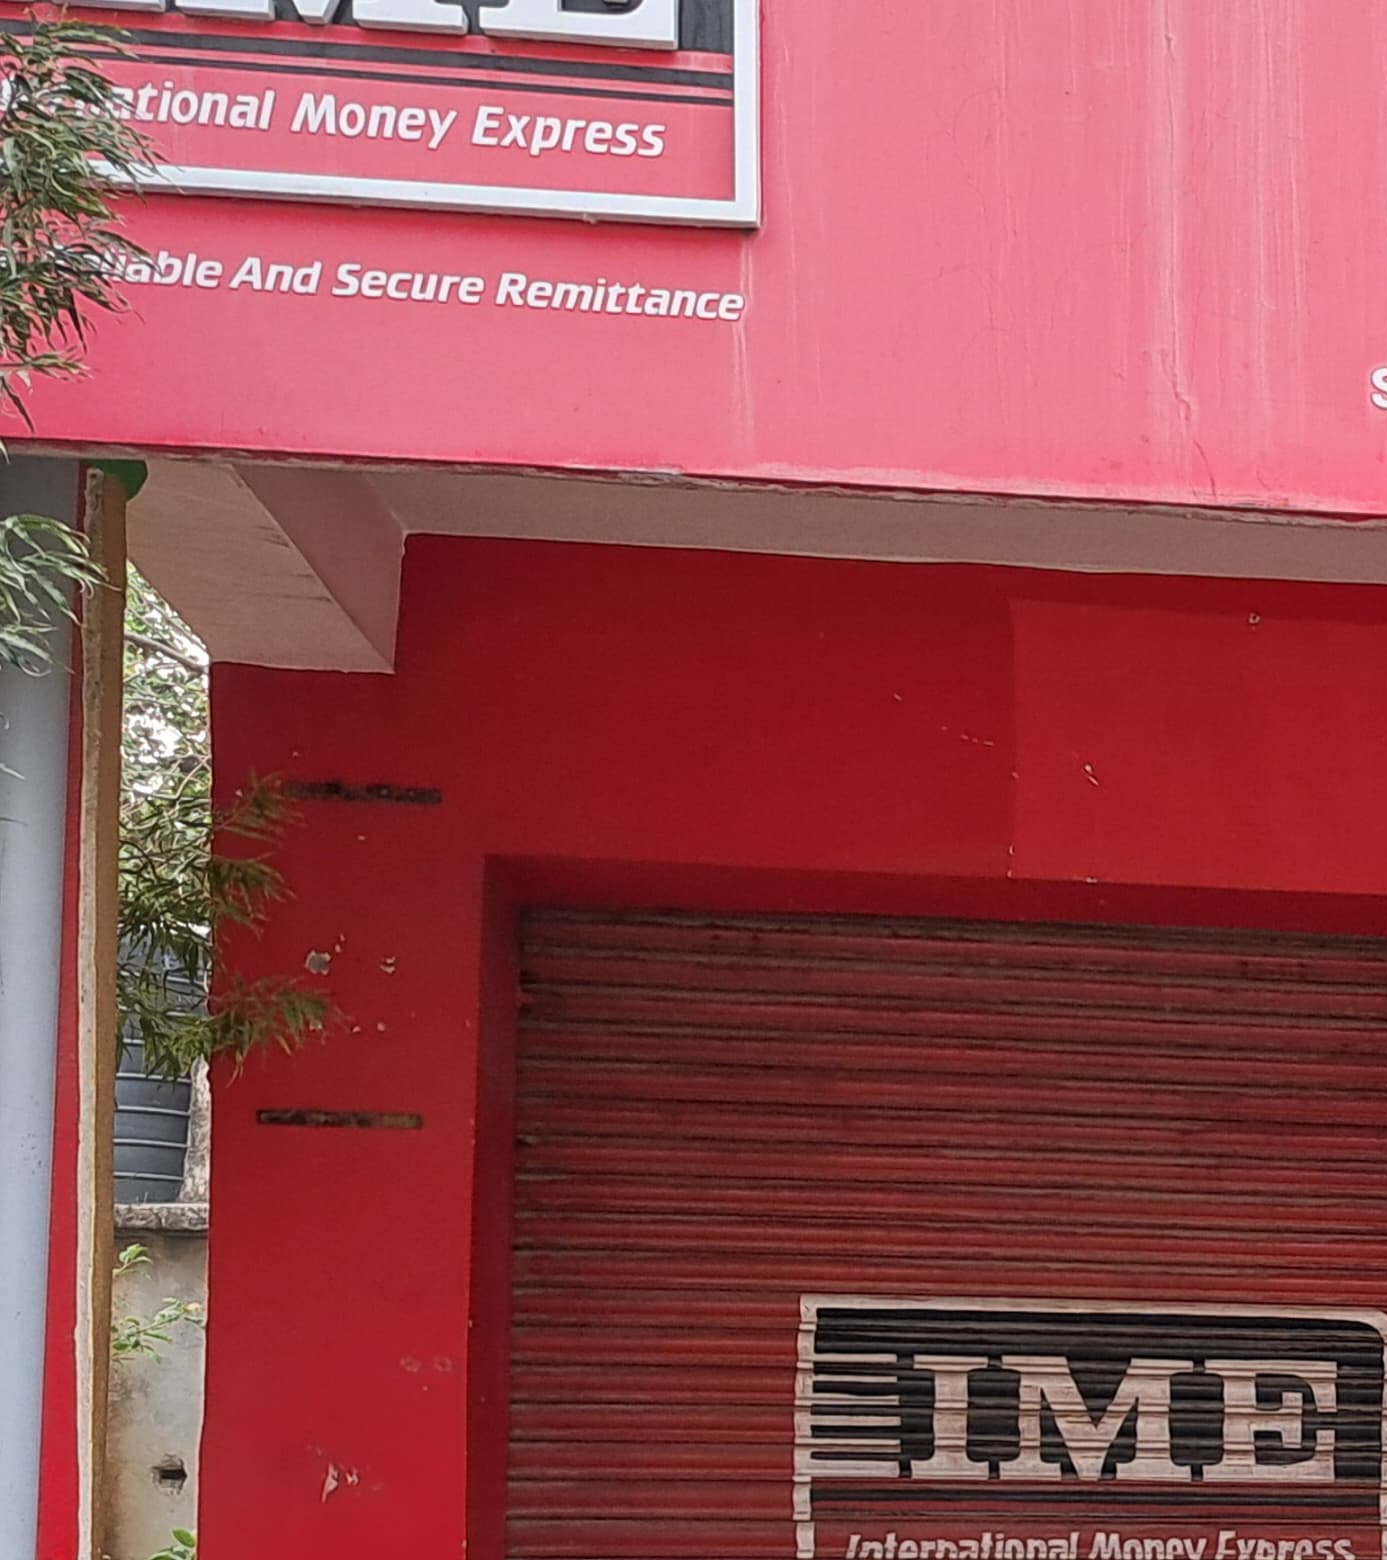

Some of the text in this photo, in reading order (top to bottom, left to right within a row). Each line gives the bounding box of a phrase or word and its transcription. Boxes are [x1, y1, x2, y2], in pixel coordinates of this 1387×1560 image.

[291, 93, 457, 152] Money
[471, 104, 667, 158] Express
[231, 256, 321, 295] And
[331, 263, 486, 305] Secure
[496, 272, 745, 322] Remittance
[910, 1354, 1339, 1484] IME
